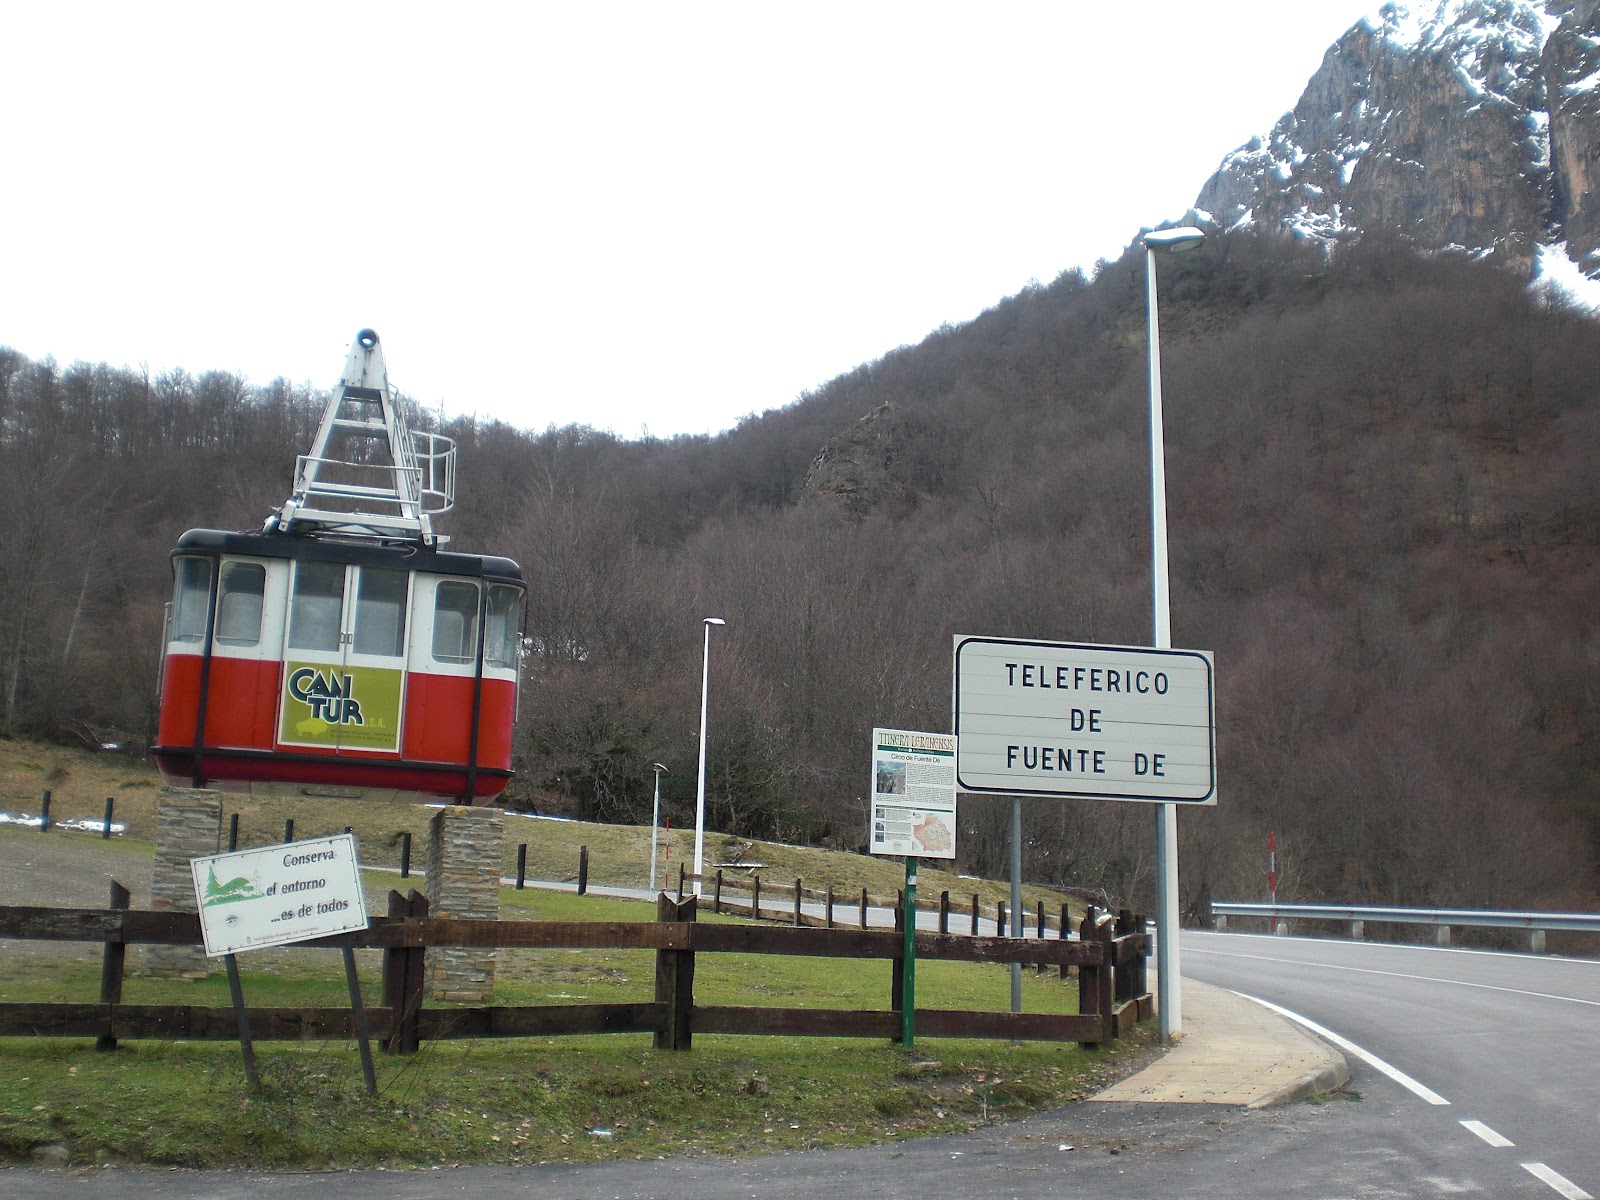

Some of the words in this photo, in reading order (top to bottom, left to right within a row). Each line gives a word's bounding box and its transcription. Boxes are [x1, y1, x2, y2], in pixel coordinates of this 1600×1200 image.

[288, 667, 353, 703] CAN
[1005, 663, 1169, 695] TELEFERICO
[306, 696, 365, 726] TUR
[1070, 708, 1102, 733] DE
[1007, 745, 1106, 774] FUENTE
[1134, 753, 1166, 777] DE
[283, 850, 335, 868] Conserva
[266, 882, 277, 897] el
[281, 878, 326, 895] entorno
[298, 904, 314, 918] de
[316, 898, 349, 914] todos
